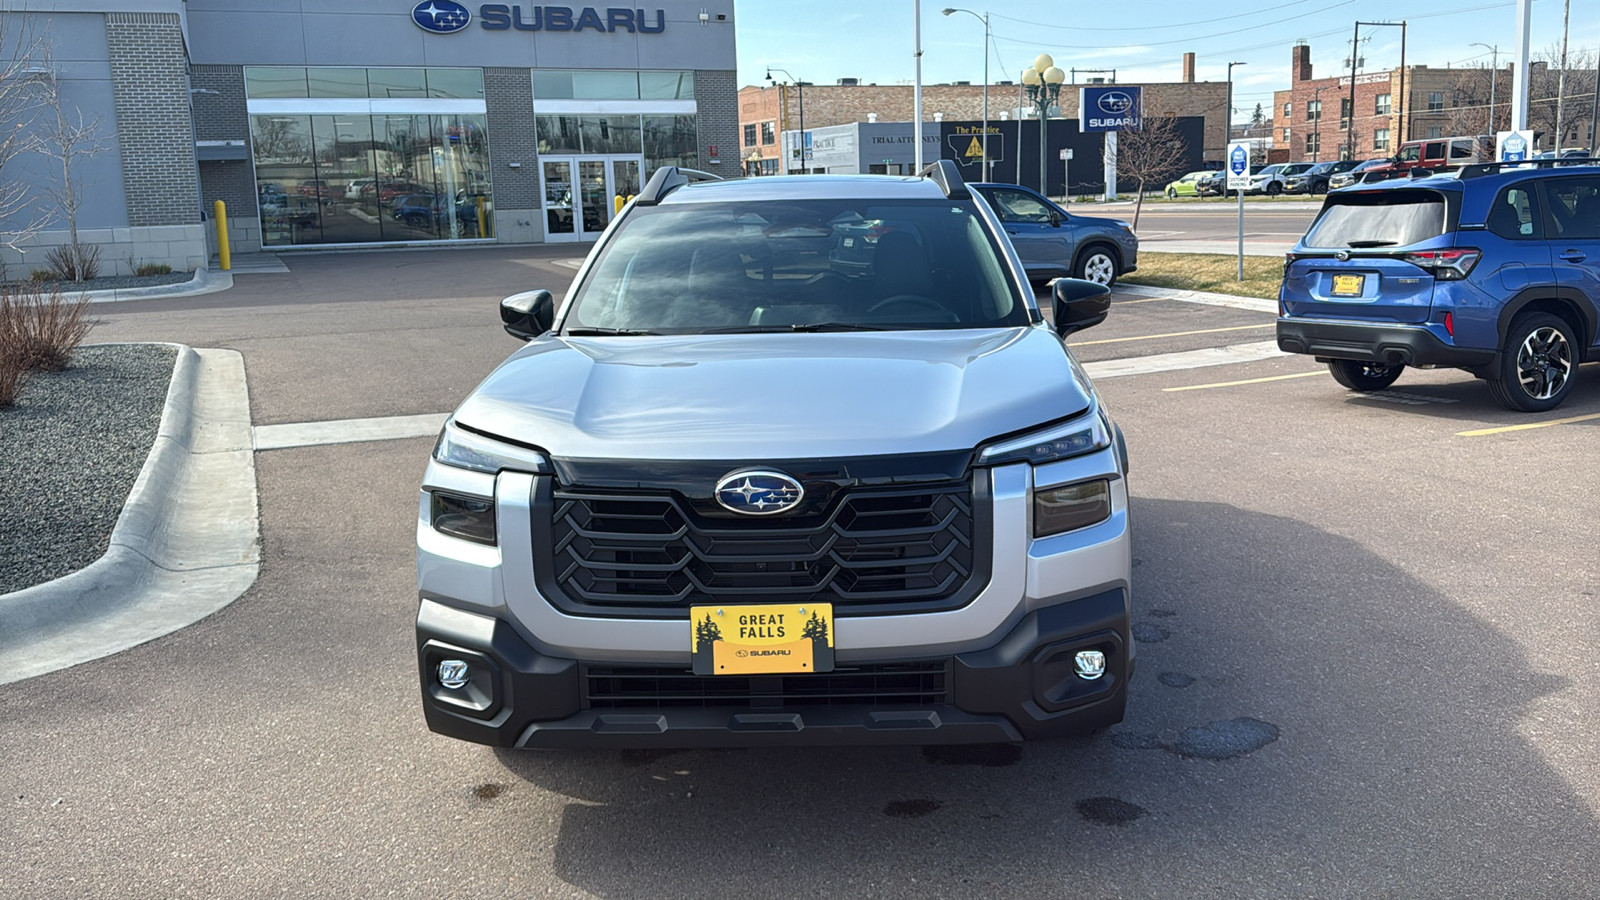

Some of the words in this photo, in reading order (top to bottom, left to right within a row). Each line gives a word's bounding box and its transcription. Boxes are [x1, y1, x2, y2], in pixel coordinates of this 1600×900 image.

[480, 4, 665, 34] SUBARU
[1089, 118, 1138, 127] SUBARU
[955, 126, 969, 134] The
[971, 126, 1000, 134] Pratice
[872, 136, 896, 144] TRIAL
[897, 136, 941, 144] ATTONEYS
[739, 614, 784, 625] GREAT
[740, 626, 785, 638] FALLS
